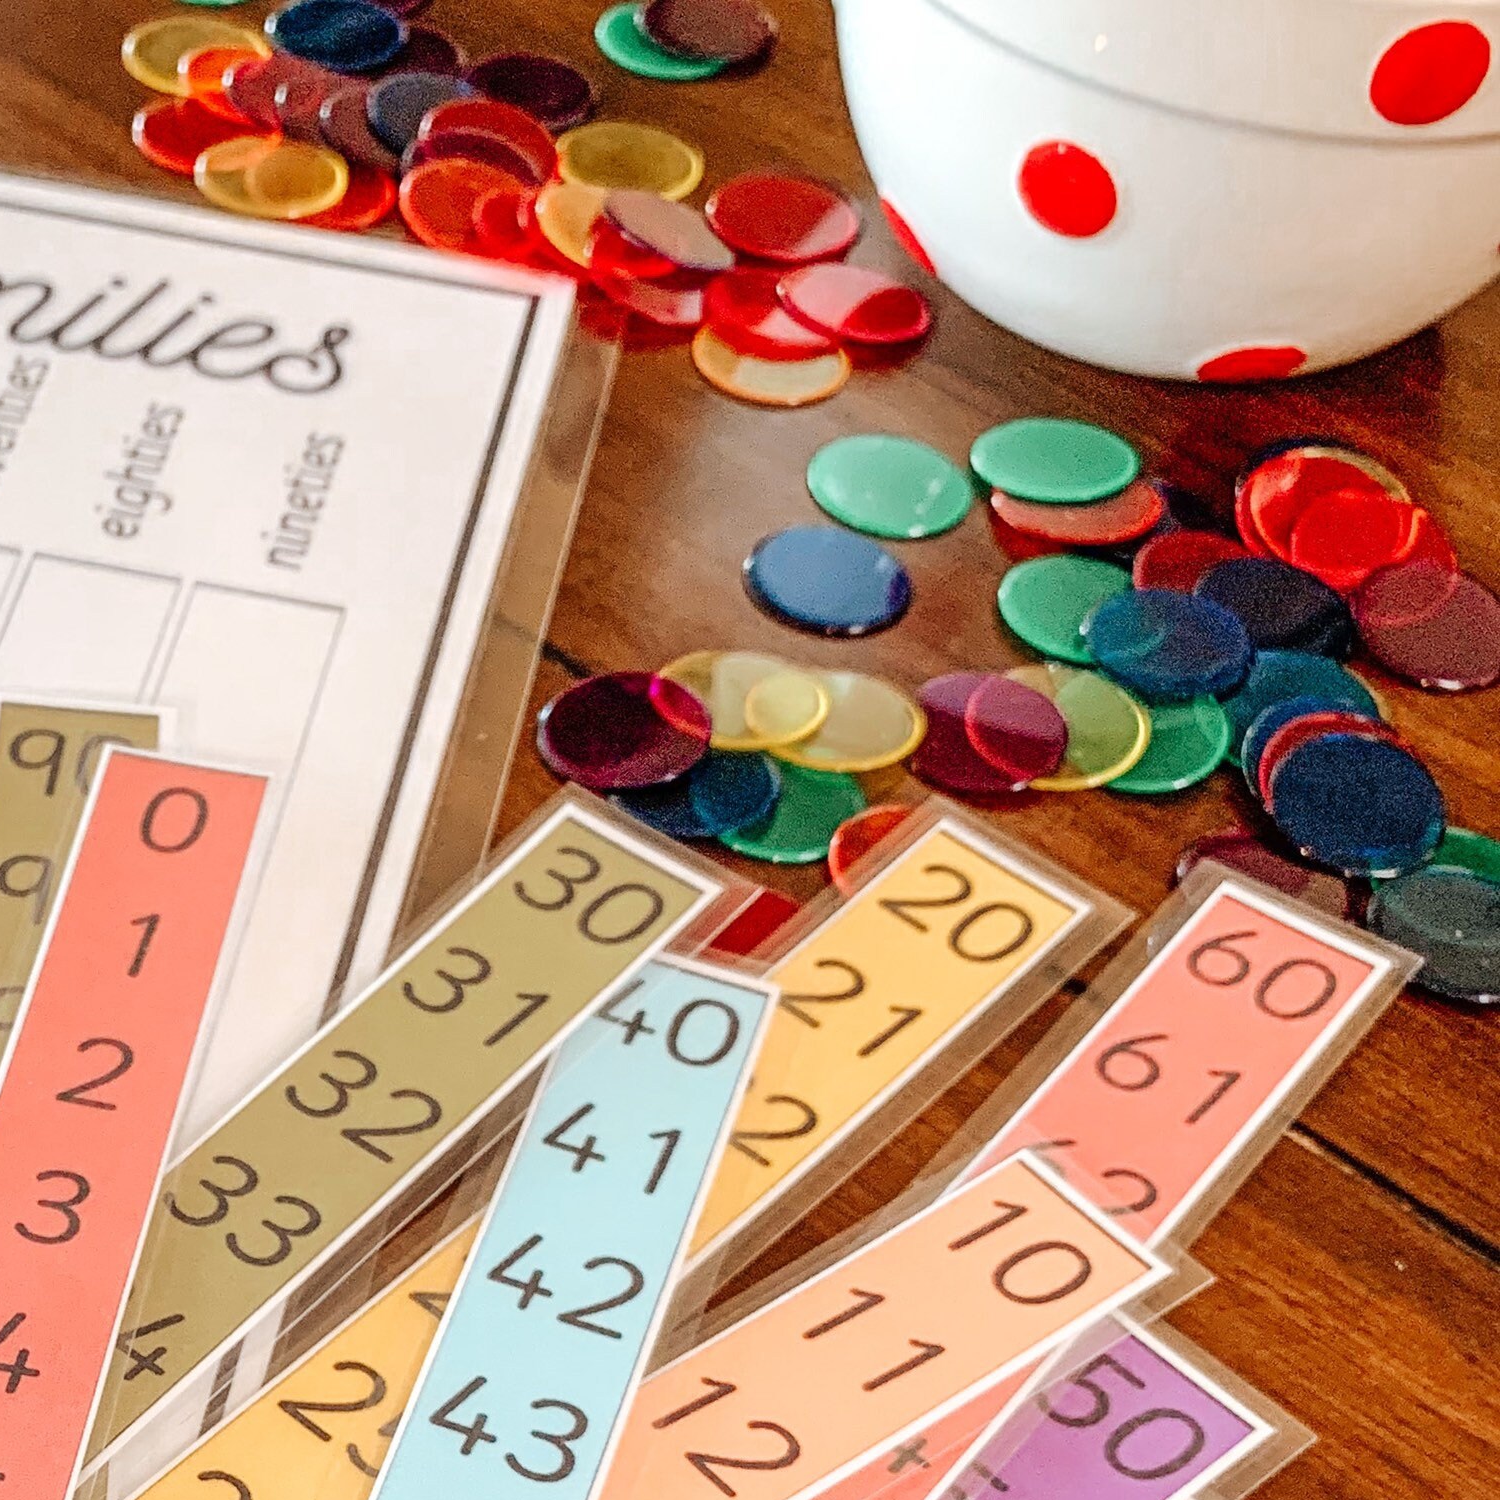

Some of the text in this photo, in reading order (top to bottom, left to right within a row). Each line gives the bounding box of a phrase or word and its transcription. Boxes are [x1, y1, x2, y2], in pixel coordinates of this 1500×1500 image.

[101, 401, 186, 541] eighties
[266, 431, 346, 572] nineties
[140, 787, 210, 853] 0
[514, 846, 664, 945] 30
[879, 864, 1034, 962] 20
[127, 913, 161, 978] 1
[1186, 929, 1338, 1020] 60
[403, 946, 551, 1046] 31
[594, 979, 742, 1067] 40
[780, 958, 925, 1058] 21
[55, 1037, 135, 1111] 2
[285, 1049, 442, 1164] 32
[1094, 1033, 1242, 1125] 61
[542, 1102, 683, 1195] 41
[728, 1094, 818, 1168] 2
[14, 1169, 91, 1244] 3
[164, 1155, 323, 1268] 33
[948, 1200, 1093, 1306] 10
[487, 1233, 645, 1340] 42
[115, 1313, 185, 1381] 4
[801, 1288, 946, 1392] 11
[429, 1375, 589, 1483] 43
[652, 1376, 801, 1498] 12
[1037, 1352, 1205, 1481] 50
